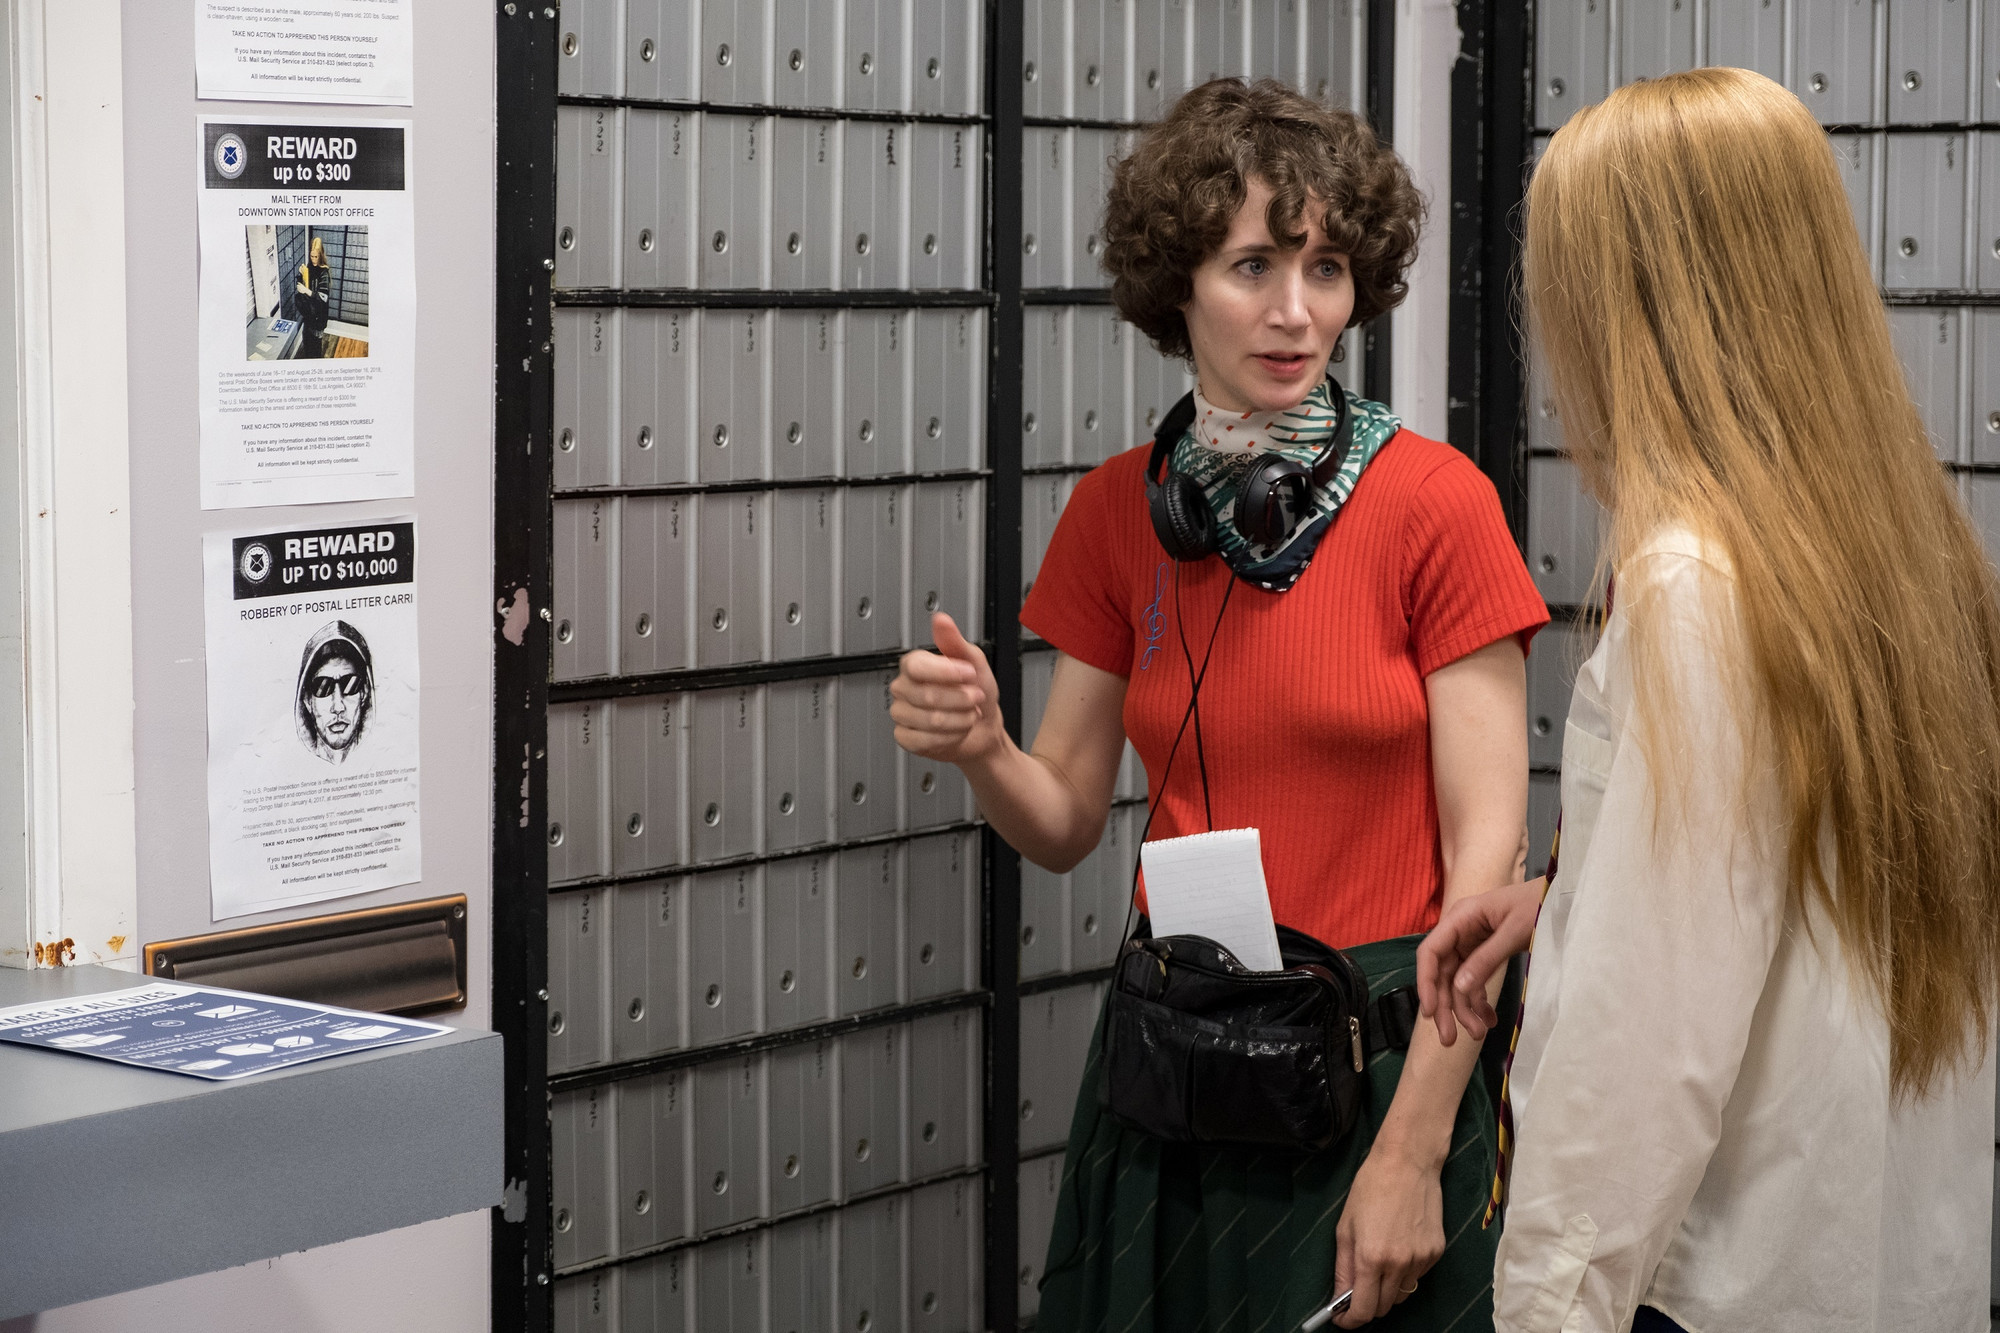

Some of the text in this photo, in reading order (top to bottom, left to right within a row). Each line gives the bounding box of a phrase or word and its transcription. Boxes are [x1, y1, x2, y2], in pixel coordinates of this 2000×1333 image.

[261, 57, 280, 65] Security
[353, 61, 368, 69] option
[316, 76, 332, 84] strictly
[596, 111, 604, 152] 222
[266, 136, 358, 160] REWARD
[273, 162, 351, 184] up to $300
[271, 195, 342, 204] MAIL THEFT FROM
[238, 208, 375, 217] DOWNTOWN STATION POST OFFICE
[594, 311, 602, 353] 223
[671, 313, 679, 353] 233
[284, 531, 396, 561] REWARD
[282, 557, 398, 585] UP TO $10,000
[240, 593, 413, 621] ROBBERY OF POSTAL LETTER CARRI
[314, 831, 345, 839] APPREHEND
[359, 825, 379, 833] PERSON
[380, 821, 406, 830] YOURSELF
[292, 859, 311, 868] Security
[312, 856, 329, 864] Service
[379, 846, 393, 855] option
[303, 848, 330, 857] information
[290, 874, 316, 883] information
[333, 870, 343, 878] kept
[344, 867, 360, 876] strictly
[54, 1006, 84, 1015] OF
[83, 1001, 126, 1010] ALL
[117, 991, 177, 1004] SIZES
